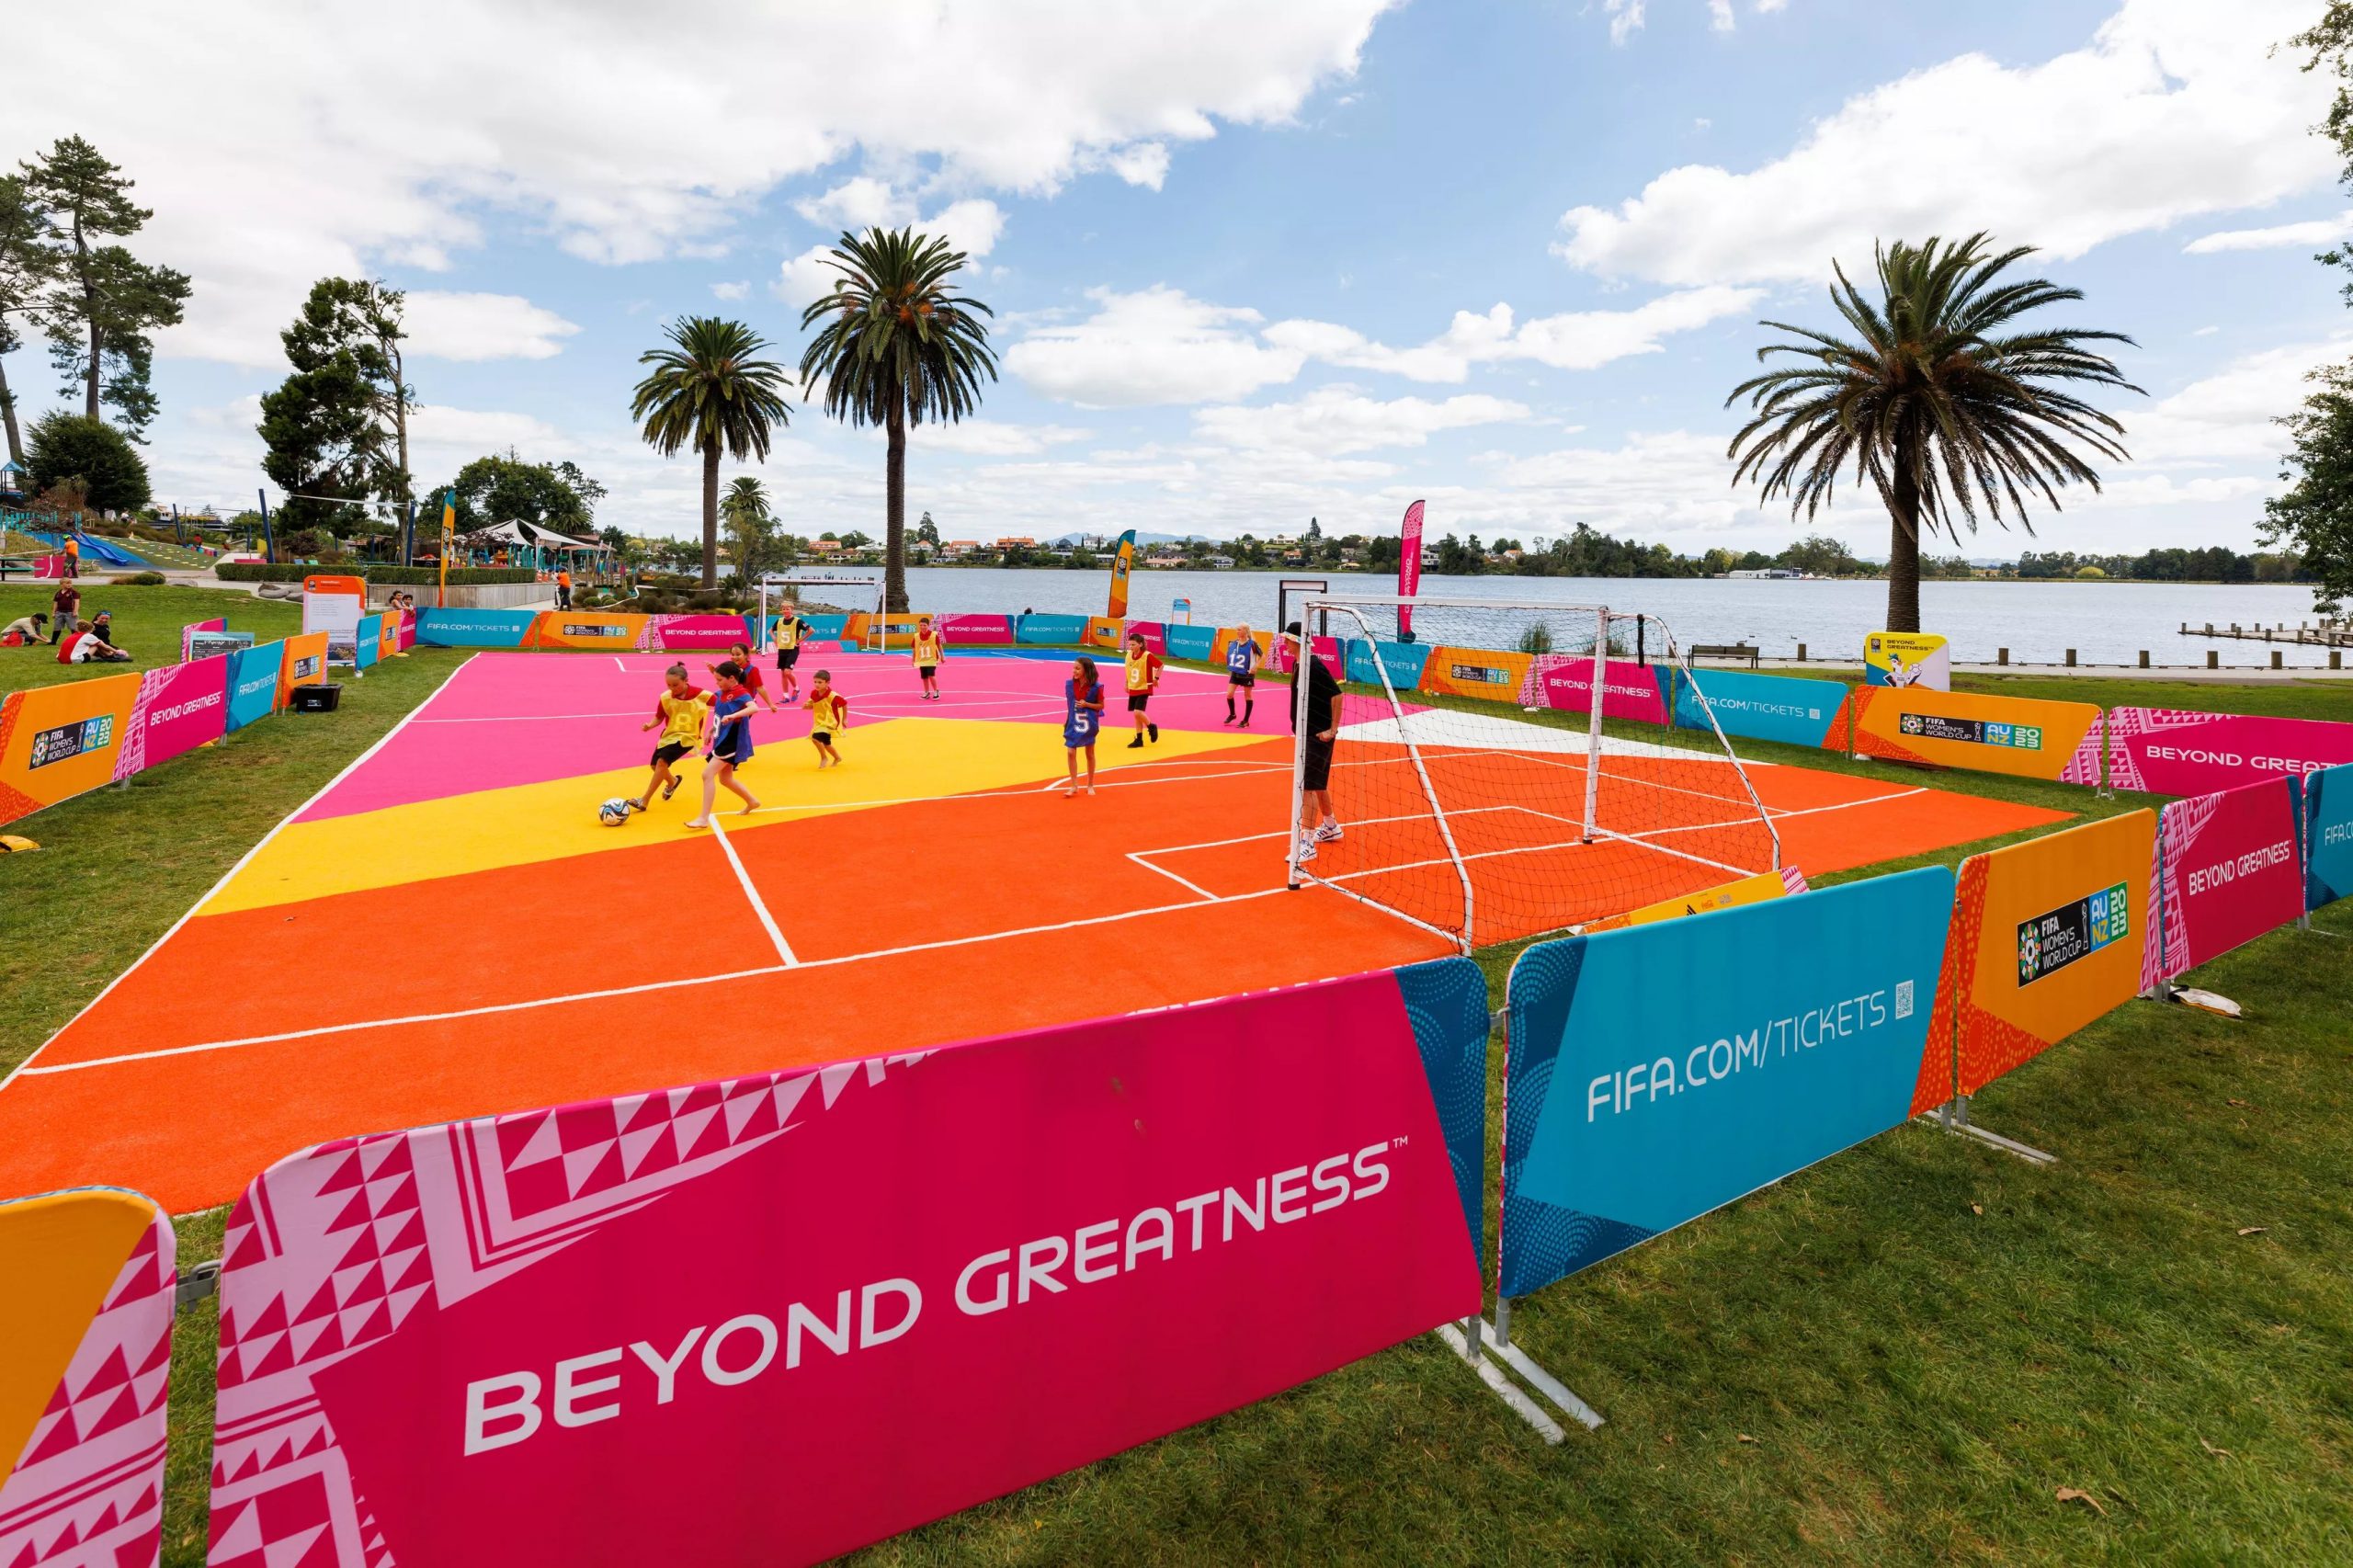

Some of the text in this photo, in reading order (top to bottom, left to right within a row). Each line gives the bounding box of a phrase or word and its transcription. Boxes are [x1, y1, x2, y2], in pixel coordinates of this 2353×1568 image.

[426, 623, 509, 631] FIFA.COM/TICKETS
[781, 631, 790, 643] 5
[921, 646, 931, 658] 11
[1229, 653, 1246, 668] 12
[1131, 668, 1140, 683] 9
[1550, 678, 1588, 689] BEYOND
[150, 705, 182, 726] BEYOND
[1074, 712, 1089, 733] 5
[1925, 717, 1946, 725] FIFA
[85, 720, 99, 735] AU
[99, 718, 112, 732] 20
[713, 713, 722, 738] 9
[1925, 723, 1964, 733] WOMEN'S
[1987, 724, 2010, 735] AU
[50, 730, 63, 742] FIFA
[97, 731, 110, 745] 23
[1925, 730, 1955, 738] WORLD
[1987, 733, 2010, 745] NZ
[2015, 727, 2040, 739] 20
[49, 736, 74, 752] WOMEN'S
[83, 734, 97, 750] NZ
[2015, 737, 2039, 748] 23
[47, 744, 76, 761] WORLD CUP
[2146, 745, 2243, 767] BEYOND
[2188, 860, 2234, 896] BEYOND
[2091, 895, 2108, 923] AU
[2110, 888, 2126, 915] 20
[2041, 916, 2060, 937] FIFA
[2111, 911, 2127, 937] 23
[2041, 926, 2075, 953] WOMEN'S
[2092, 919, 2109, 946] NZ
[2042, 939, 2082, 970] WORLD CUP
[1587, 990, 1886, 1123] FIFA.COM/TICKETS
[463, 1278, 923, 1457] BEYOND
